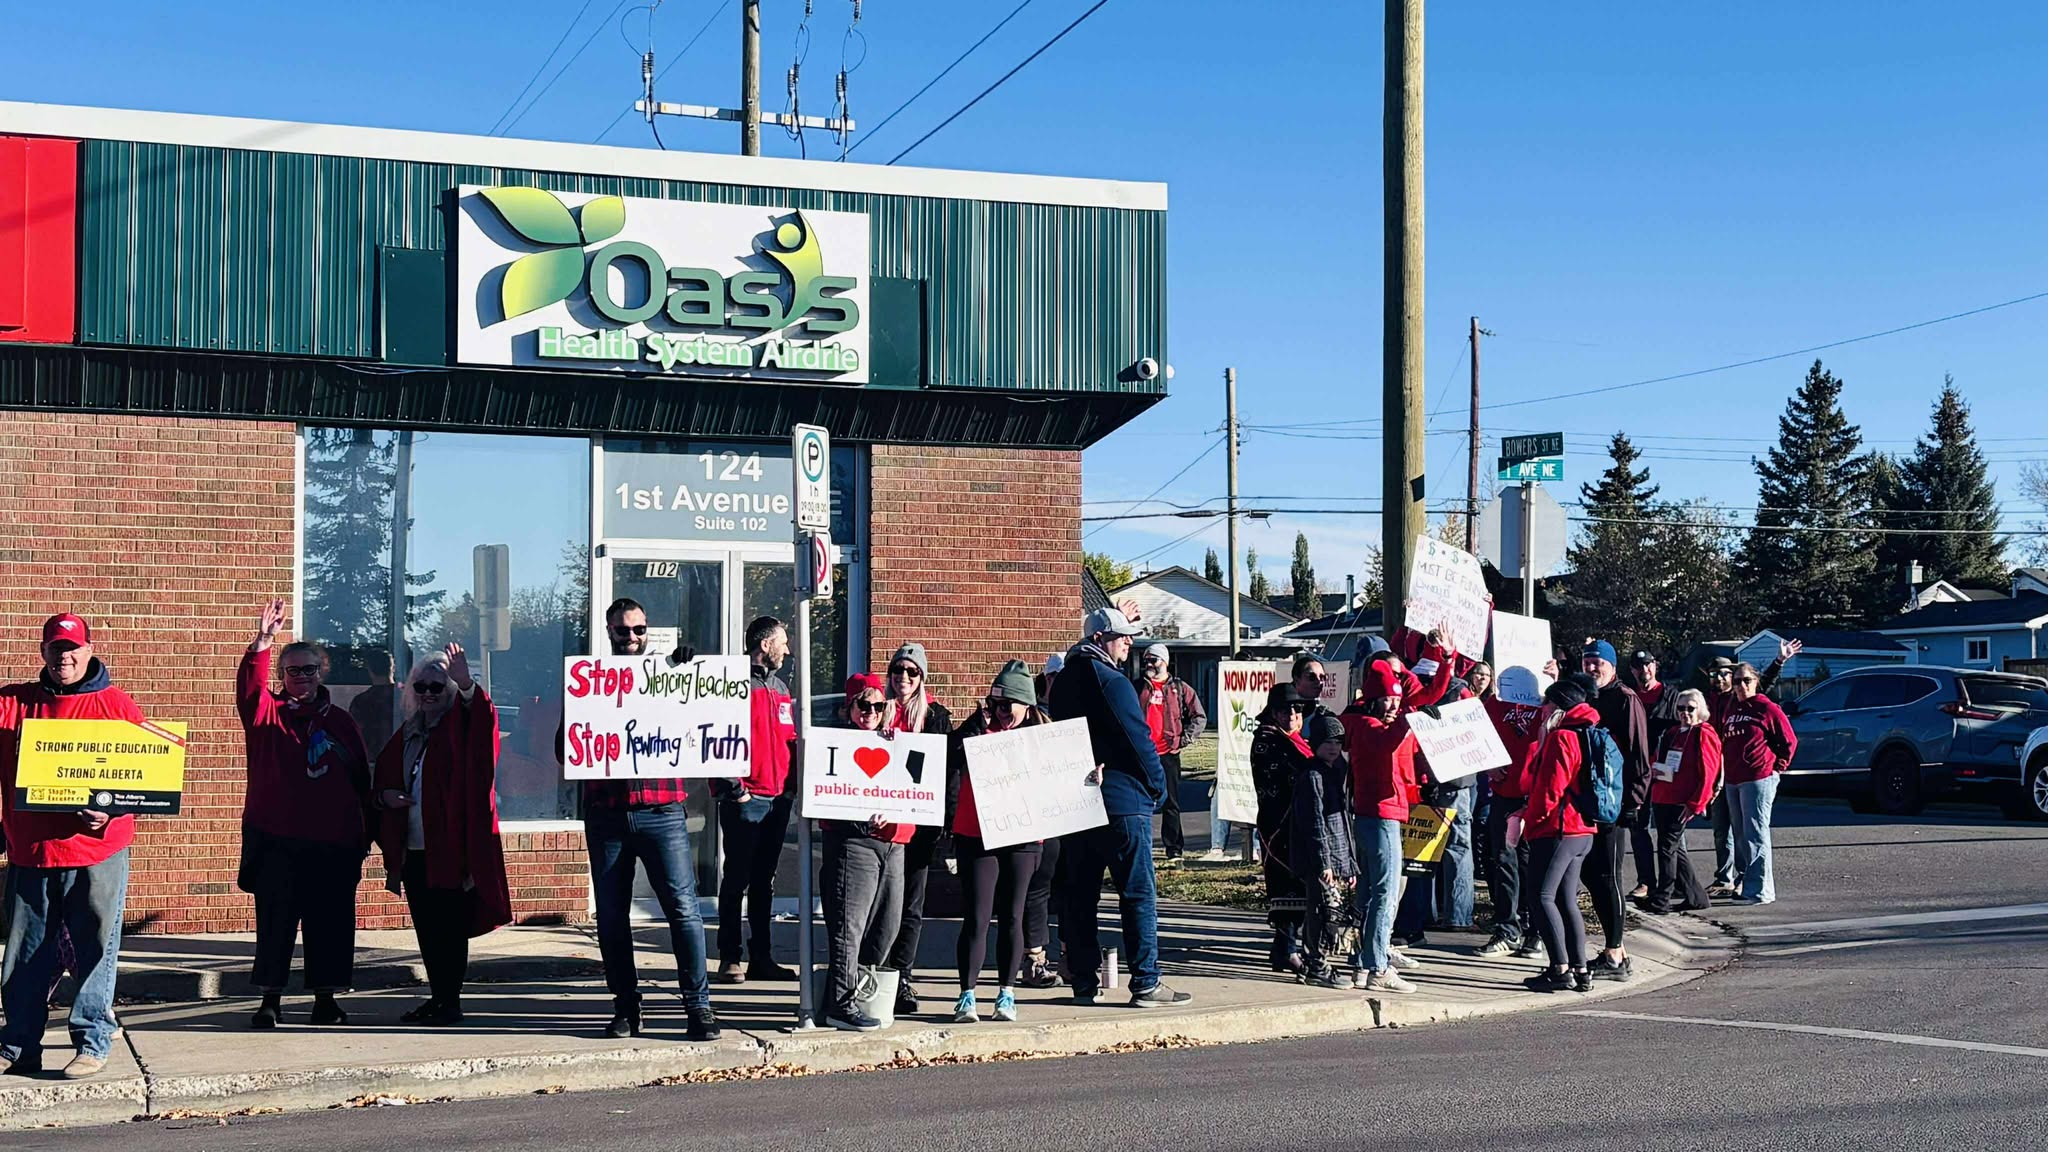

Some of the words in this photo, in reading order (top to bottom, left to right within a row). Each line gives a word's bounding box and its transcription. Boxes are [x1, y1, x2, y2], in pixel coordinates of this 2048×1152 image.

[590, 208, 860, 331] Oasis
[538, 327, 640, 361] Health
[645, 332, 753, 371] System
[759, 338, 859, 371] Airdrie
[808, 441, 819, 471] P
[1505, 437, 1538, 457] BOWERS
[1541, 438, 1549, 452] ST
[1551, 438, 1559, 451] NE
[699, 449, 763, 482] 124
[1519, 462, 1537, 477] AVE
[1542, 463, 1556, 477] NE
[615, 482, 663, 511] 1st
[670, 485, 789, 514] Avenue
[694, 515, 735, 531] Suite
[740, 517, 767, 531] 102
[649, 562, 677, 577] 102
[567, 658, 634, 708] Stop
[639, 658, 693, 704] Silencing
[693, 660, 750, 700] Teachers
[1224, 670, 1248, 692] NOW
[1249, 671, 1276, 692] OPEN
[35, 740, 74, 753] STRONG
[76, 741, 112, 753] PUBLIC
[115, 743, 170, 755] EDUCATION
[568, 721, 621, 777] Stop
[625, 719, 681, 775] Rewriting
[698, 723, 749, 764] Truth
[968, 732, 1025, 757] Support
[57, 766, 96, 779] STRONG
[98, 768, 143, 780] ALBERTA
[825, 746, 839, 776] I
[814, 783, 860, 797] public
[863, 786, 935, 801] education
[980, 796, 1032, 833] Fund
